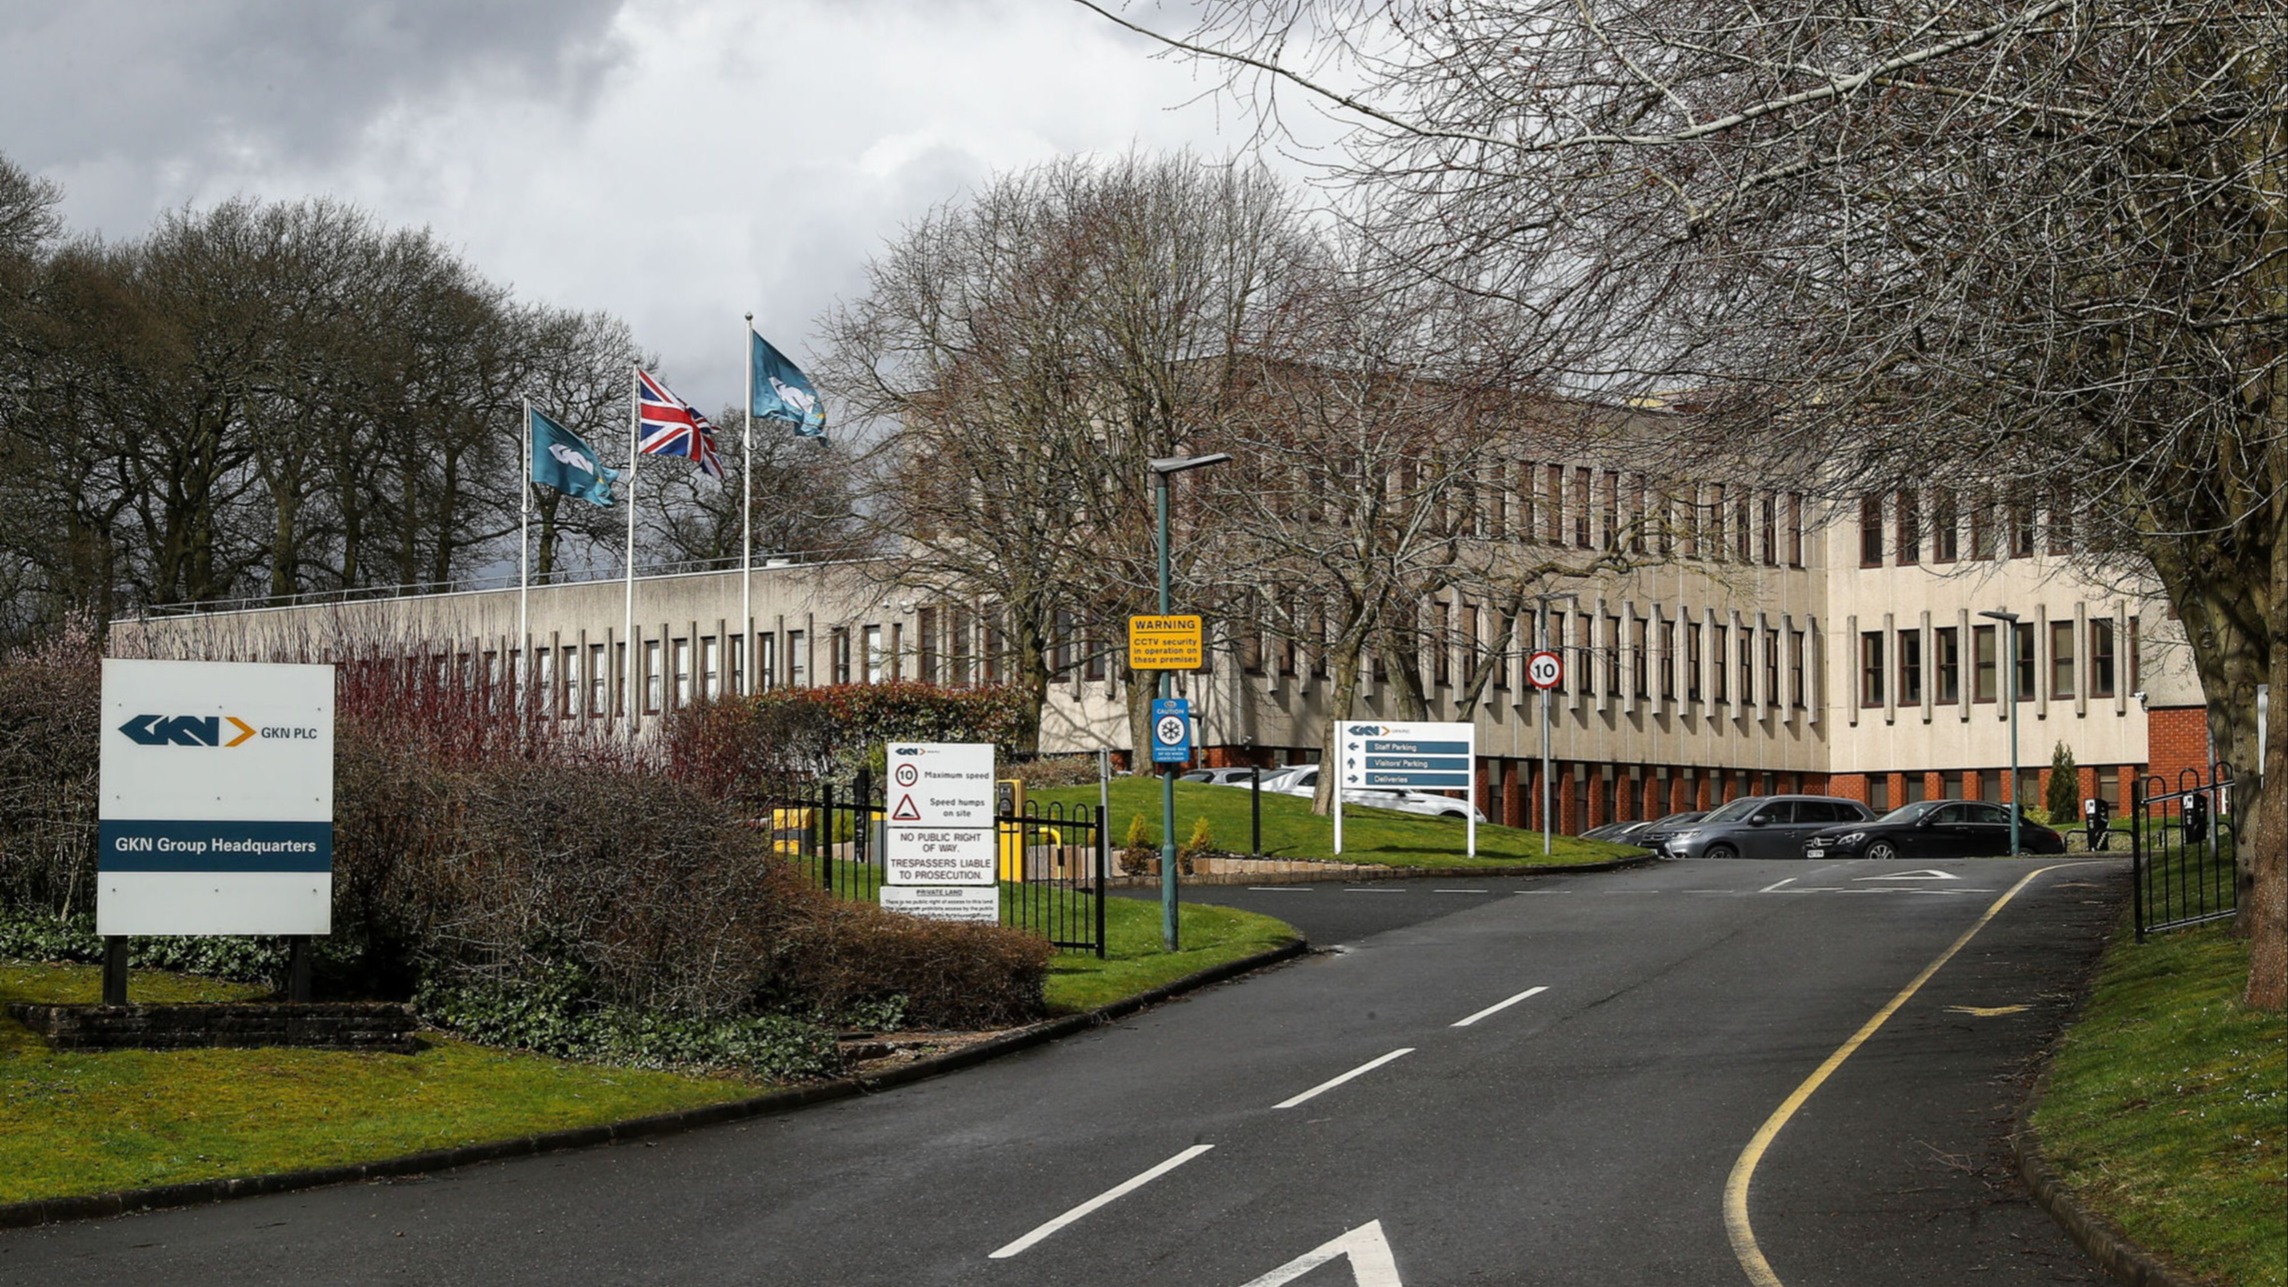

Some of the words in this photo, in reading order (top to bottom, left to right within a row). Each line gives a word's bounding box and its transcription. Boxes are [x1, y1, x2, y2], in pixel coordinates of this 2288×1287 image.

[1135, 620, 1196, 630] WARNING
[1134, 638, 1159, 646] CCTV
[1162, 638, 1197, 647] security
[1144, 647, 1183, 655] operation
[1160, 656, 1197, 664] premises
[1534, 663, 1556, 678] 10
[117, 714, 220, 747] GKN
[261, 727, 290, 739] GKN
[294, 728, 318, 740] PLC
[1374, 743, 1391, 751] Staff
[1391, 744, 1417, 752] Parking
[1403, 760, 1428, 769] Parking
[900, 771, 913, 780] 10
[924, 771, 963, 779] Maximum
[965, 771, 990, 780] speed
[1374, 775, 1408, 783] Deliveries
[929, 798, 956, 807] Speed
[958, 798, 985, 807] humps
[956, 810, 971, 818] site
[900, 833, 915, 842] NO
[917, 833, 951, 842] PUBLIC
[953, 833, 981, 842] RIGHT
[115, 837, 153, 852] GKN
[157, 837, 207, 855] Group
[211, 838, 317, 855] Headquarters
[922, 844, 936, 852] OF
[938, 844, 960, 853] WAY.
[890, 858, 957, 868] TRESPASSERS
[960, 859, 991, 868] LIABLE
[899, 870, 912, 879] TO
[915, 870, 983, 880] PROSECUTION.
